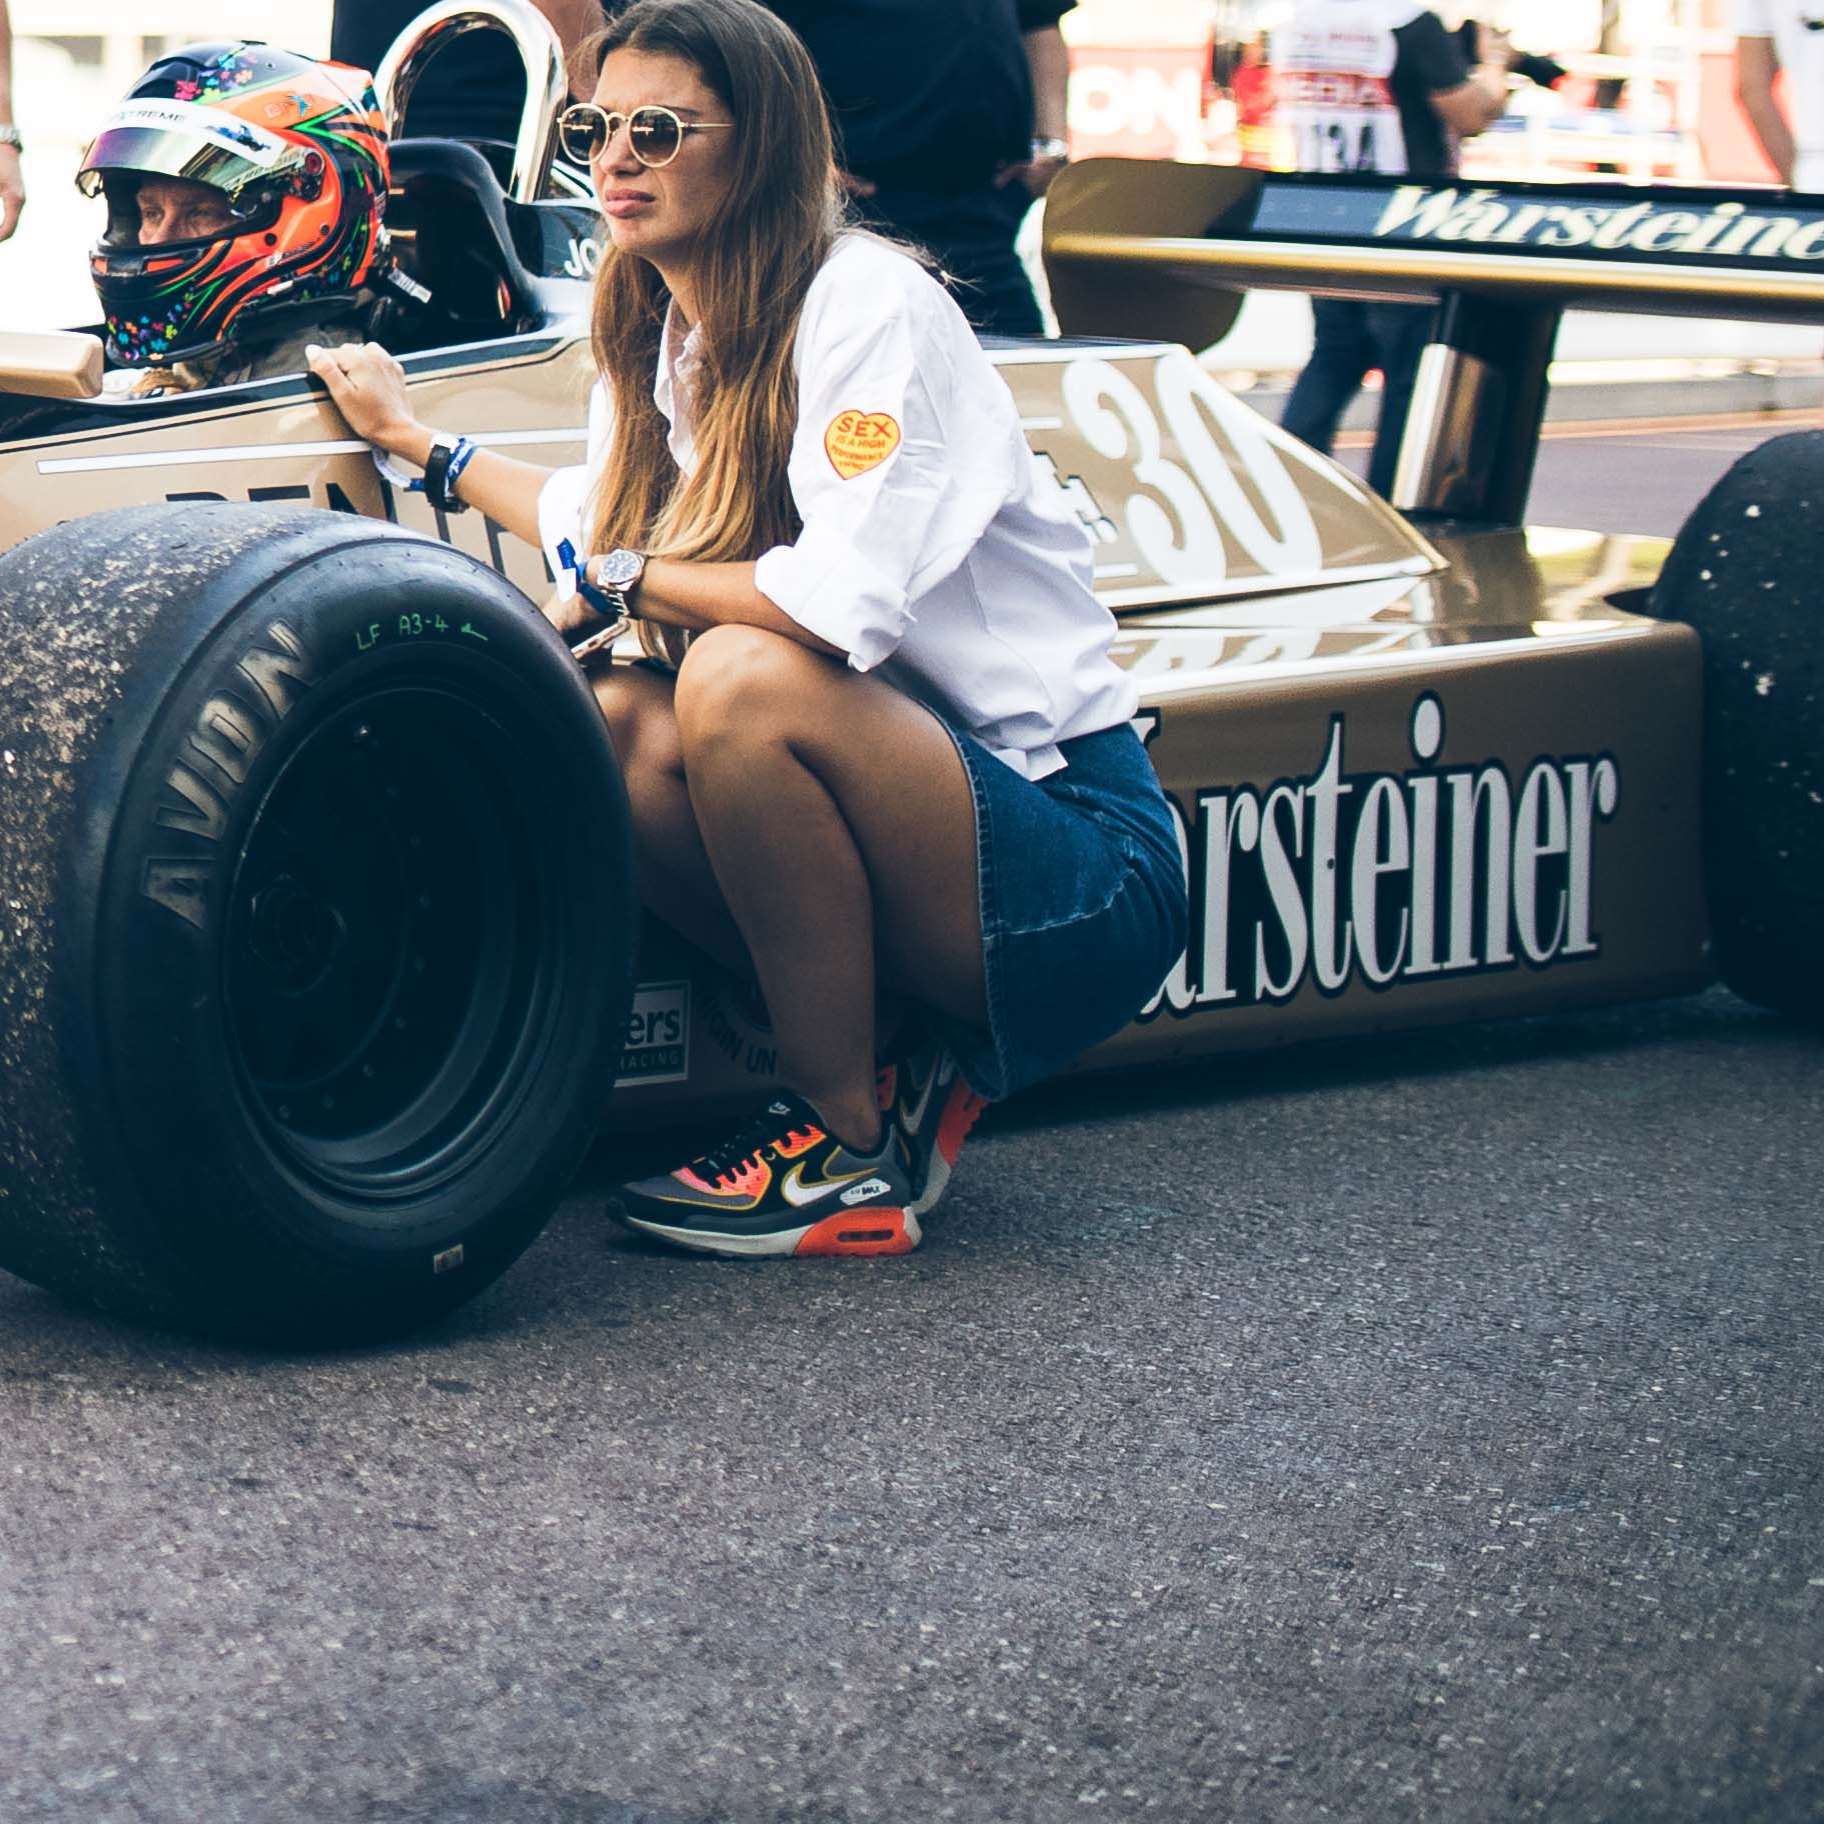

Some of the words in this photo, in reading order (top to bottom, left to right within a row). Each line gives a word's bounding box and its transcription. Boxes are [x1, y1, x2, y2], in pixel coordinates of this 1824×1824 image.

[837, 416, 892, 439] SEX
[1062, 357, 1323, 587] 30
[356, 623, 381, 651] LF
[399, 612, 450, 635] A3-4
[141, 617, 313, 930] AVON
[1131, 689, 1621, 1024] rsteiner
[625, 1008, 681, 1046] ers
